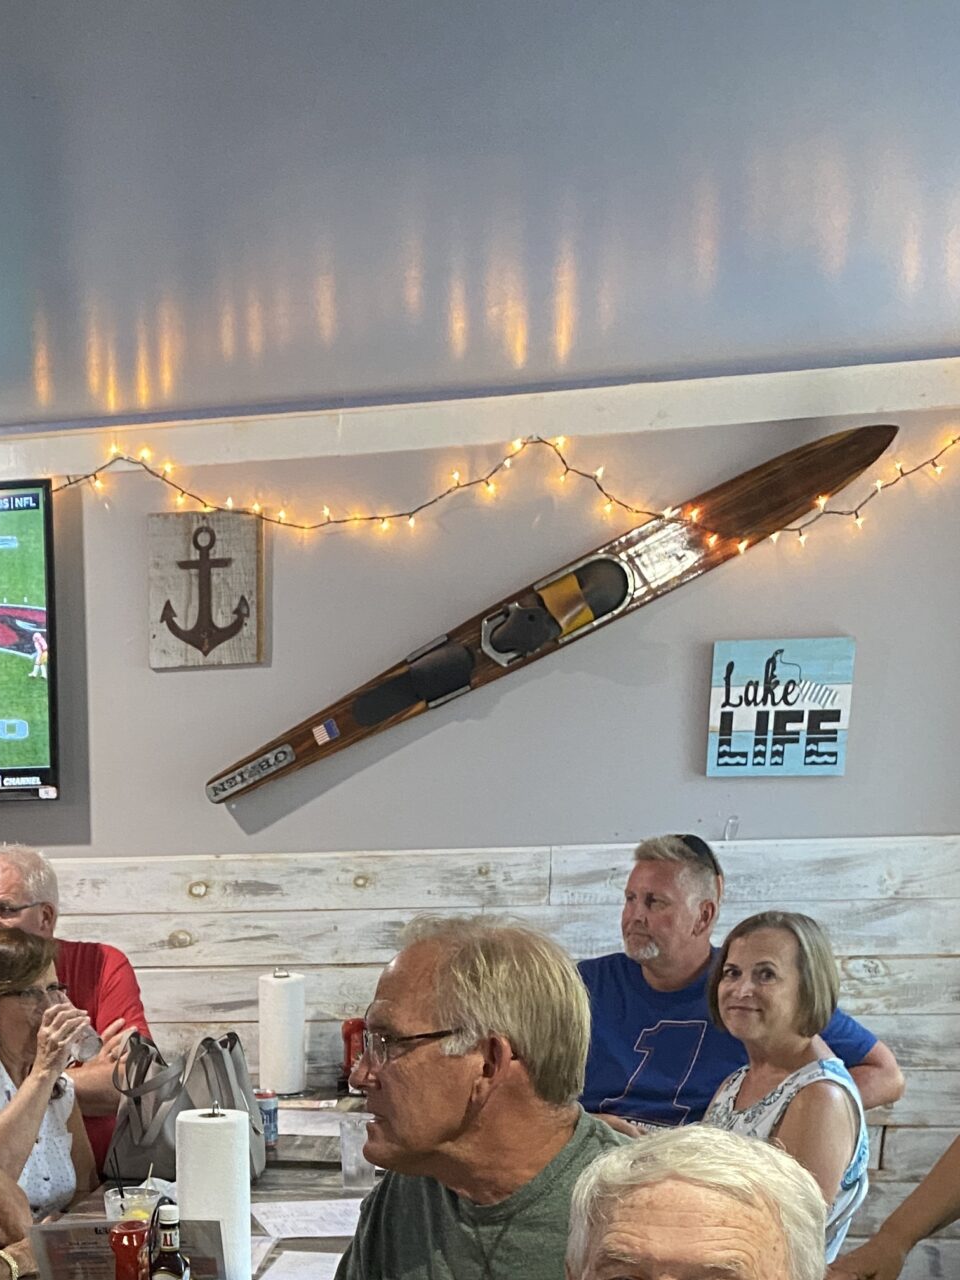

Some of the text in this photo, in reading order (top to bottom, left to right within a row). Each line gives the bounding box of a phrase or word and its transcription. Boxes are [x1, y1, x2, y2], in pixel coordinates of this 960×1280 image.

[14, 496, 36, 508] NFL
[720, 650, 801, 709] Lake
[716, 709, 842, 767] LIFE
[3, 776, 42, 786] CHANNEL
[600, 1019, 708, 1127] 1
